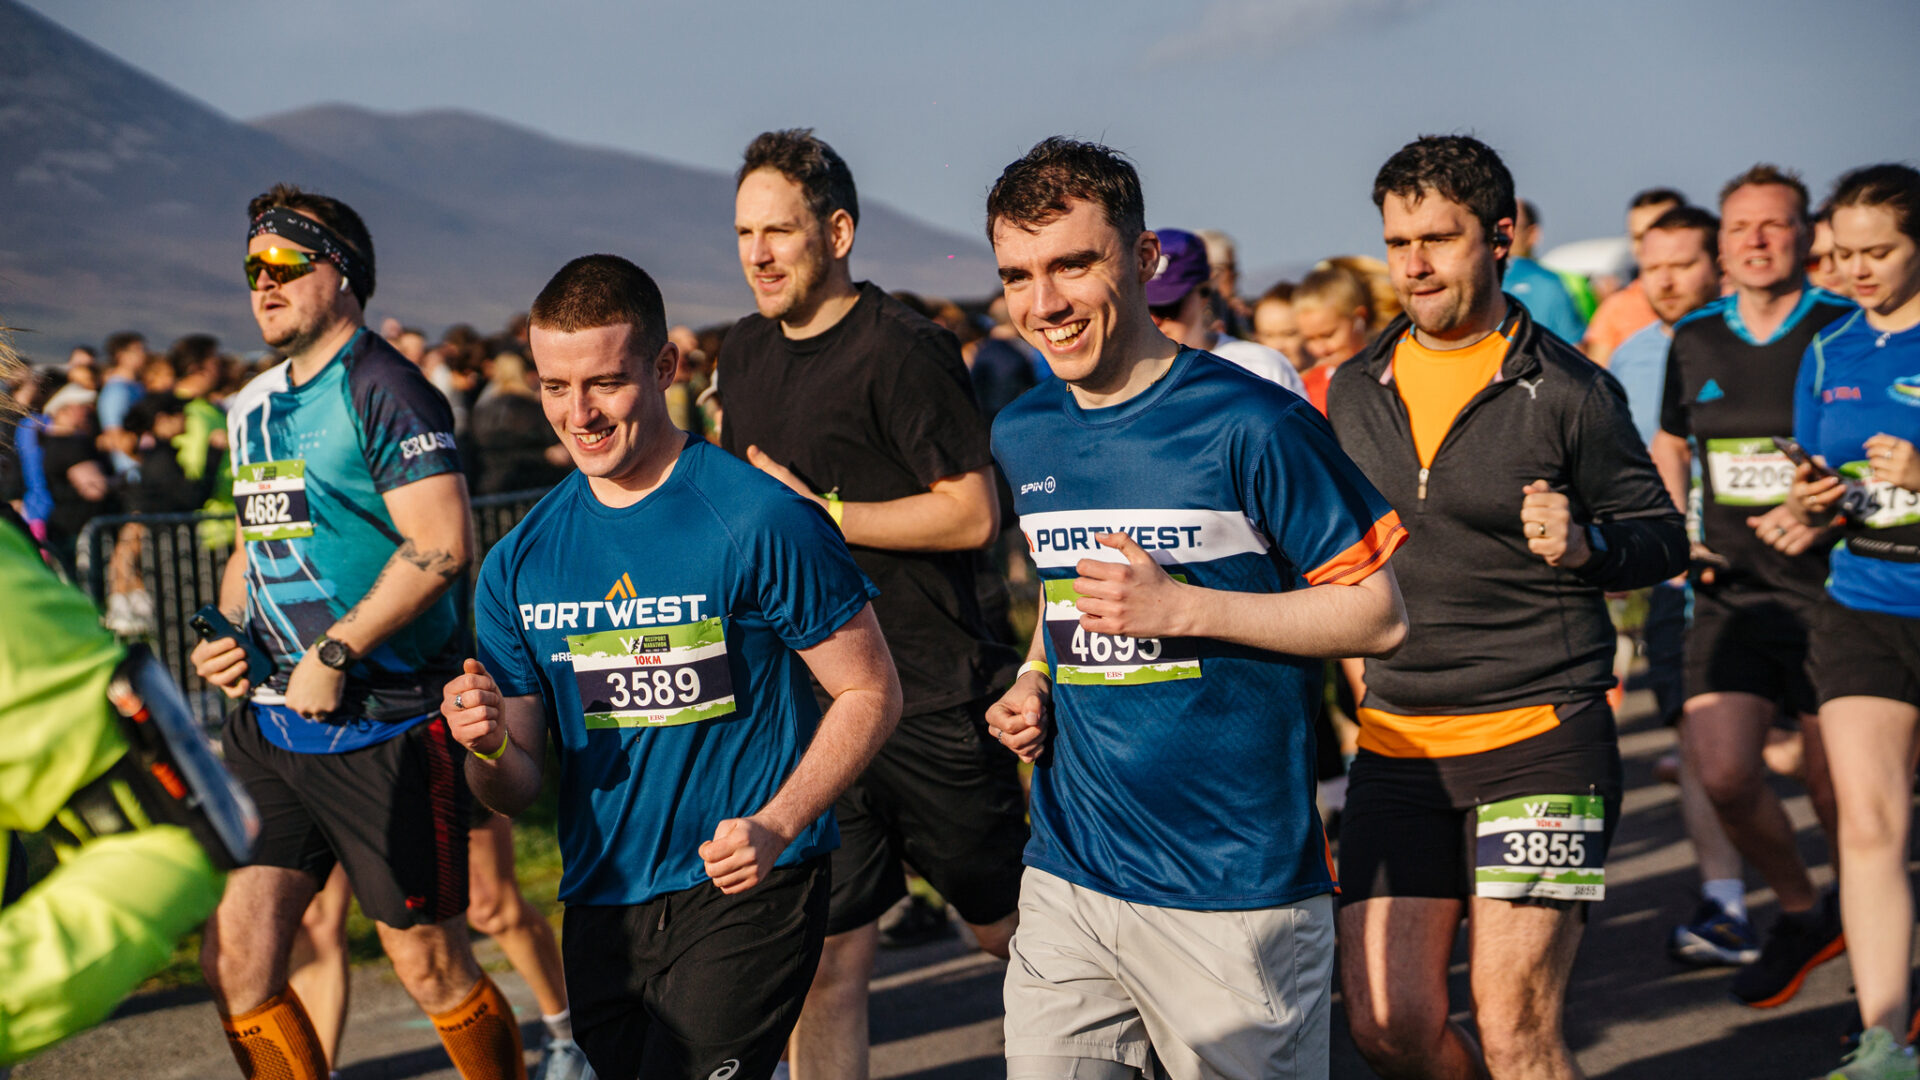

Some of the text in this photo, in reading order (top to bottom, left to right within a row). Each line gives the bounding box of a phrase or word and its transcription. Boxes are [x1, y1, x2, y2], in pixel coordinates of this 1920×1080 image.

[1728, 465, 1793, 488] 2206
[244, 492, 293, 525] 4682
[519, 593, 707, 631] PORTWEST
[1070, 622, 1162, 662] 4695
[634, 655, 662, 665] 10KM
[1106, 671, 1123, 679] EBS
[606, 667, 701, 708] 3589
[1503, 831, 1586, 867] 3855
